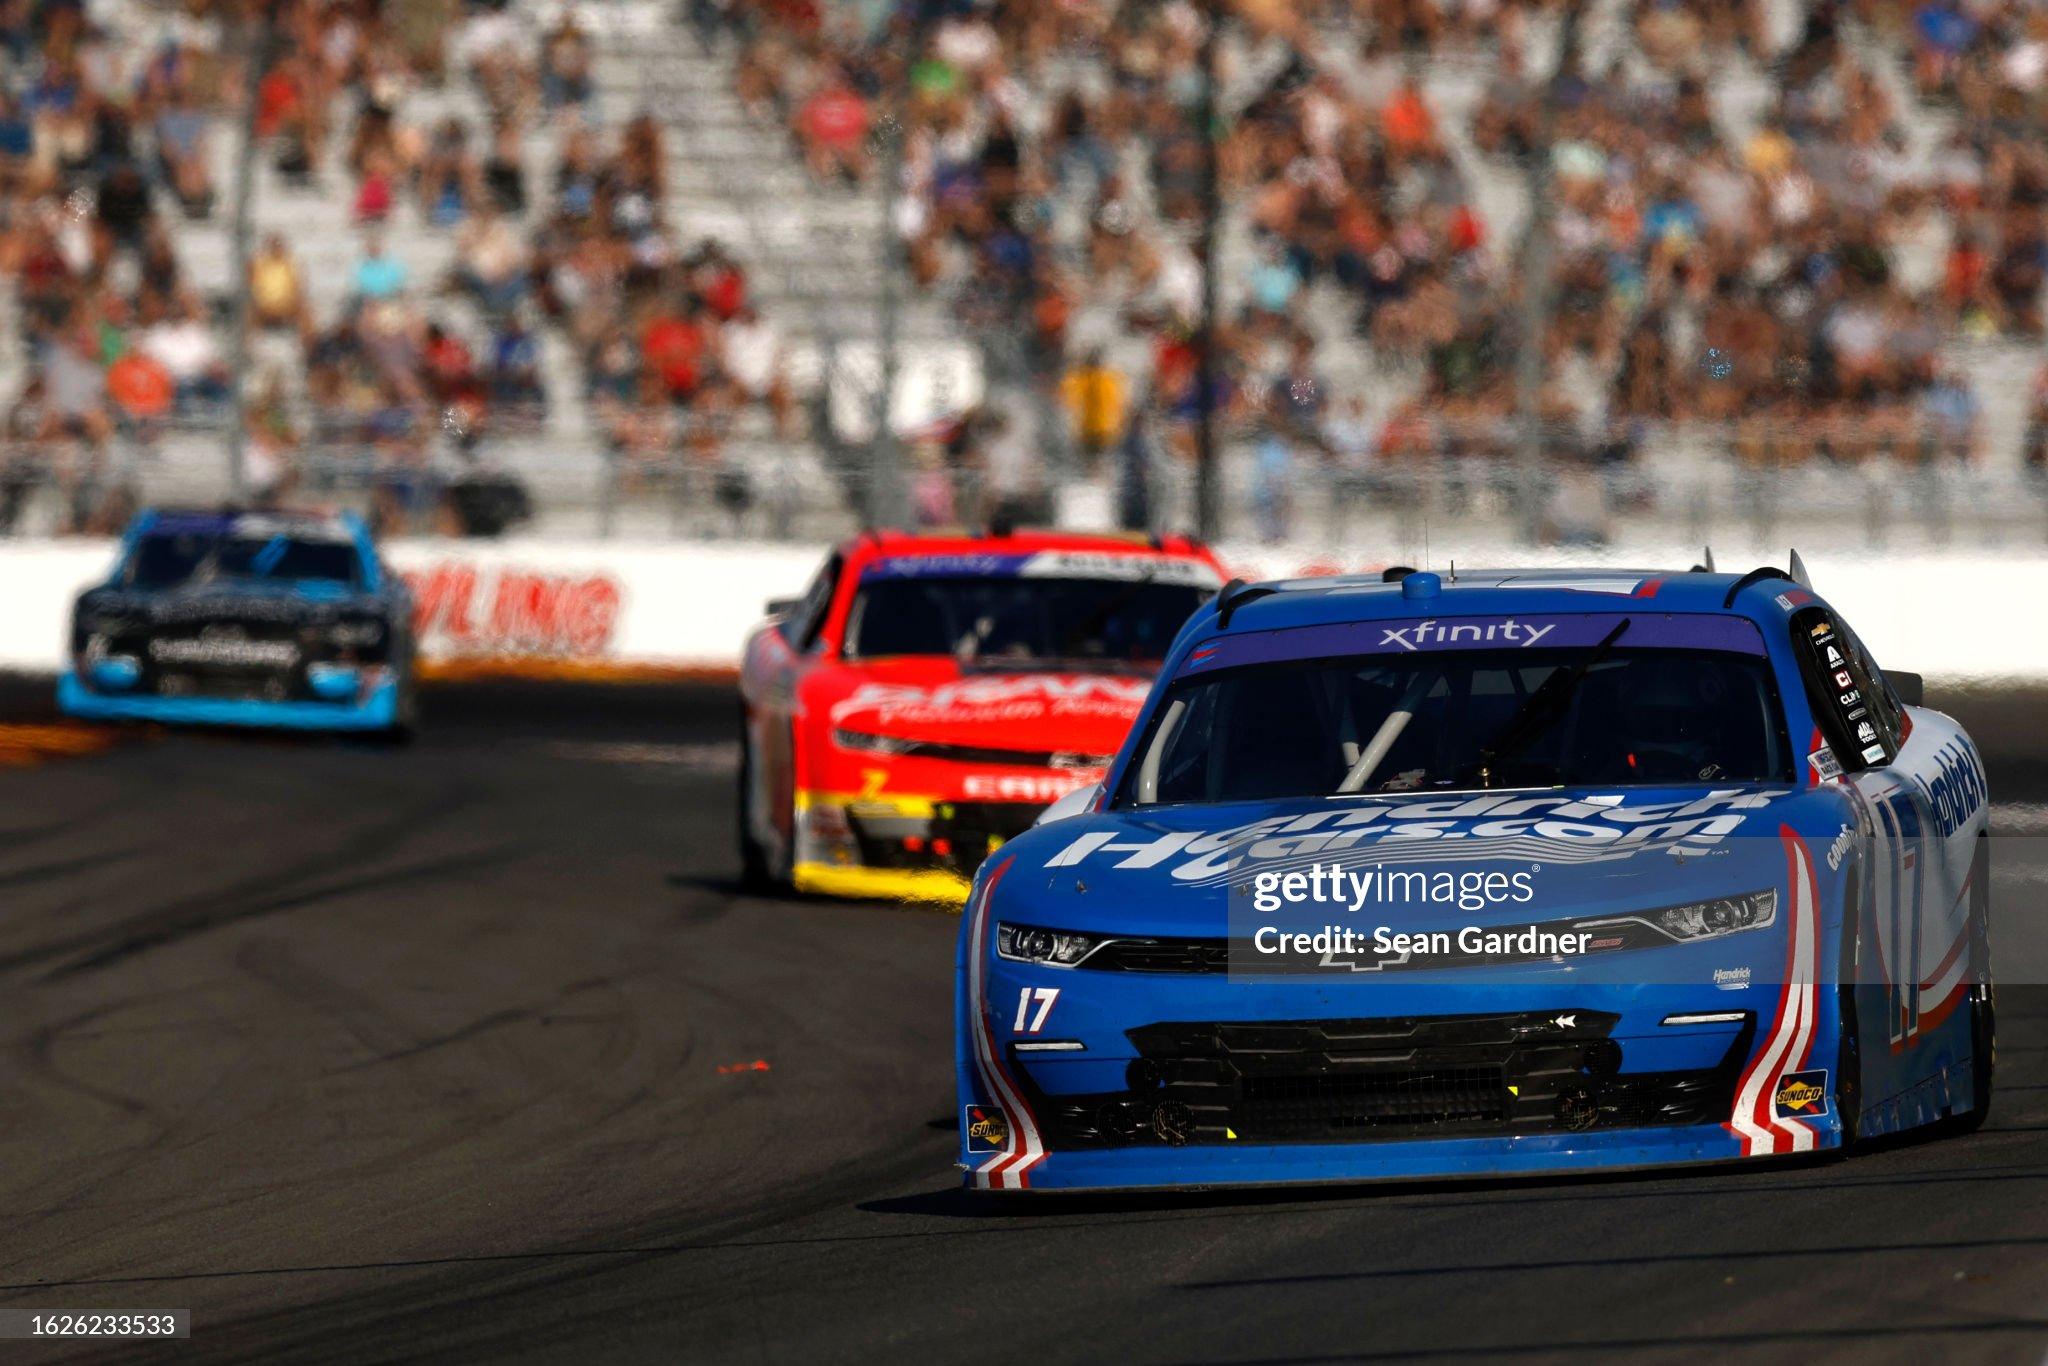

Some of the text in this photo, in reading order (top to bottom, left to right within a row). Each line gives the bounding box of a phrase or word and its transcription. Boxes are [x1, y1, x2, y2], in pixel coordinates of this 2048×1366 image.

[1378, 620, 1557, 651] xfinity
[1043, 789, 1792, 869] Hendrick
[1713, 967, 1751, 984] Hendrick
[1013, 987, 1060, 1034] 17
[1778, 1088, 1821, 1103] SUNOCO
